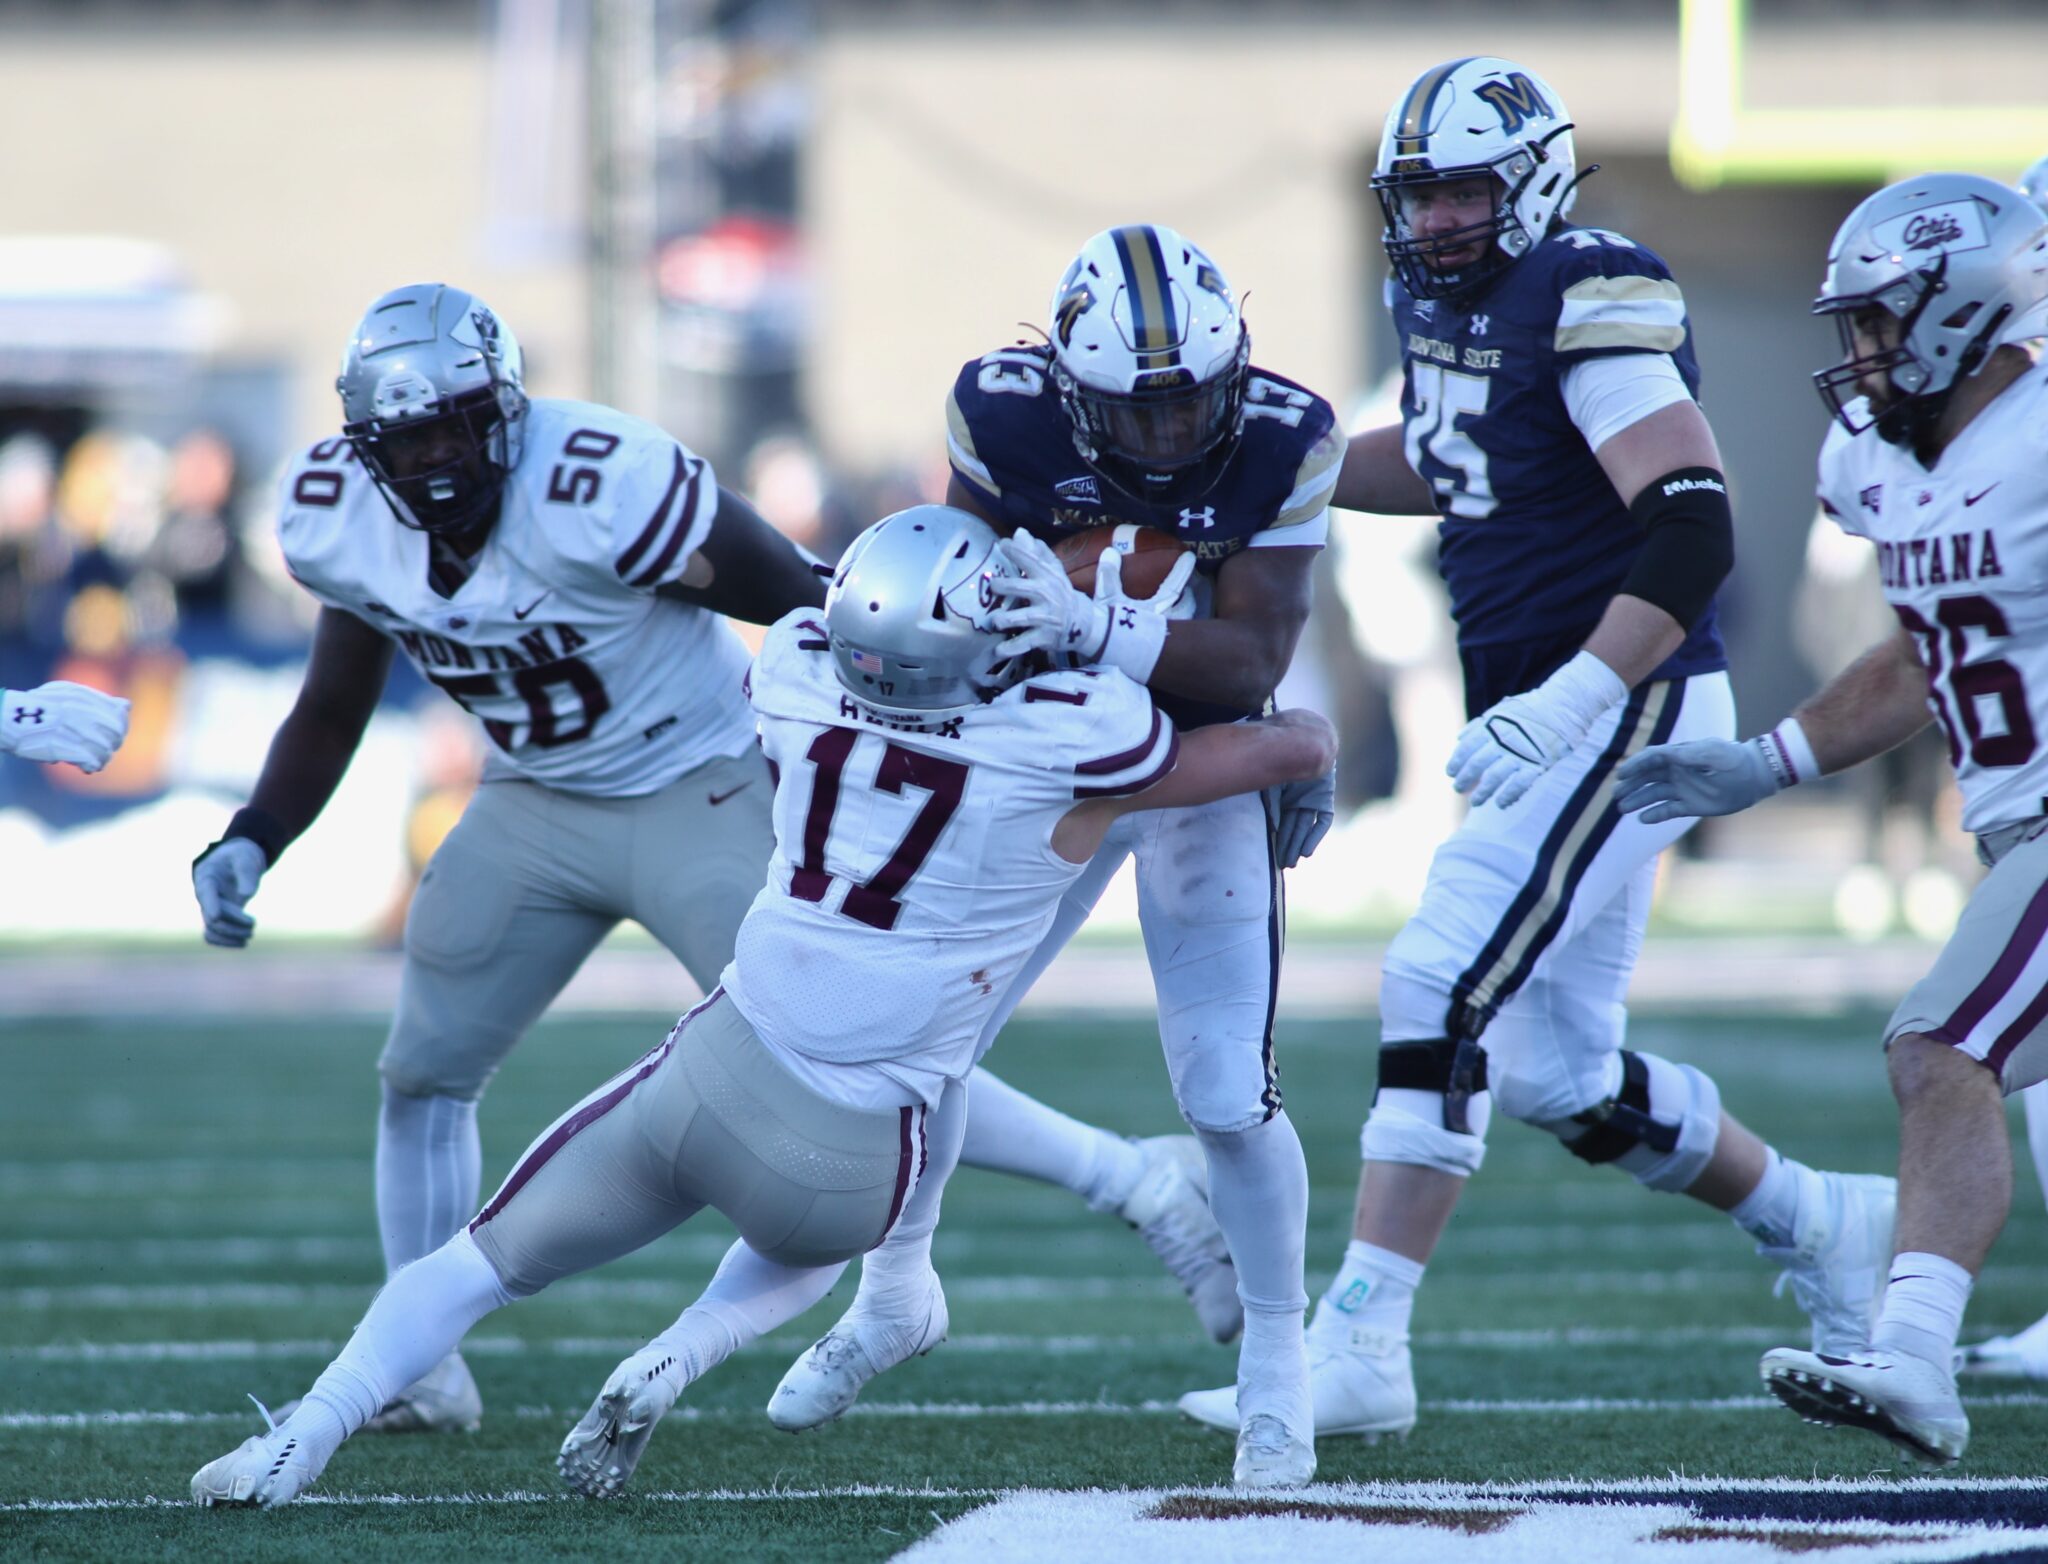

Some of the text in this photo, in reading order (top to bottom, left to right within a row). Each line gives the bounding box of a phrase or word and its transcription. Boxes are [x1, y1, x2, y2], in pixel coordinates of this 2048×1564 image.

[1473, 72, 1556, 137] M
[1148, 371, 1181, 386] 406
[1242, 376, 1314, 429] 13
[546, 428, 621, 504] 50
[1404, 359, 1501, 519] 75
[1182, 536, 1241, 559] TATE
[1879, 529, 2003, 589] ONTANA
[879, 681, 894, 697] 17
[788, 726, 974, 932] 17
